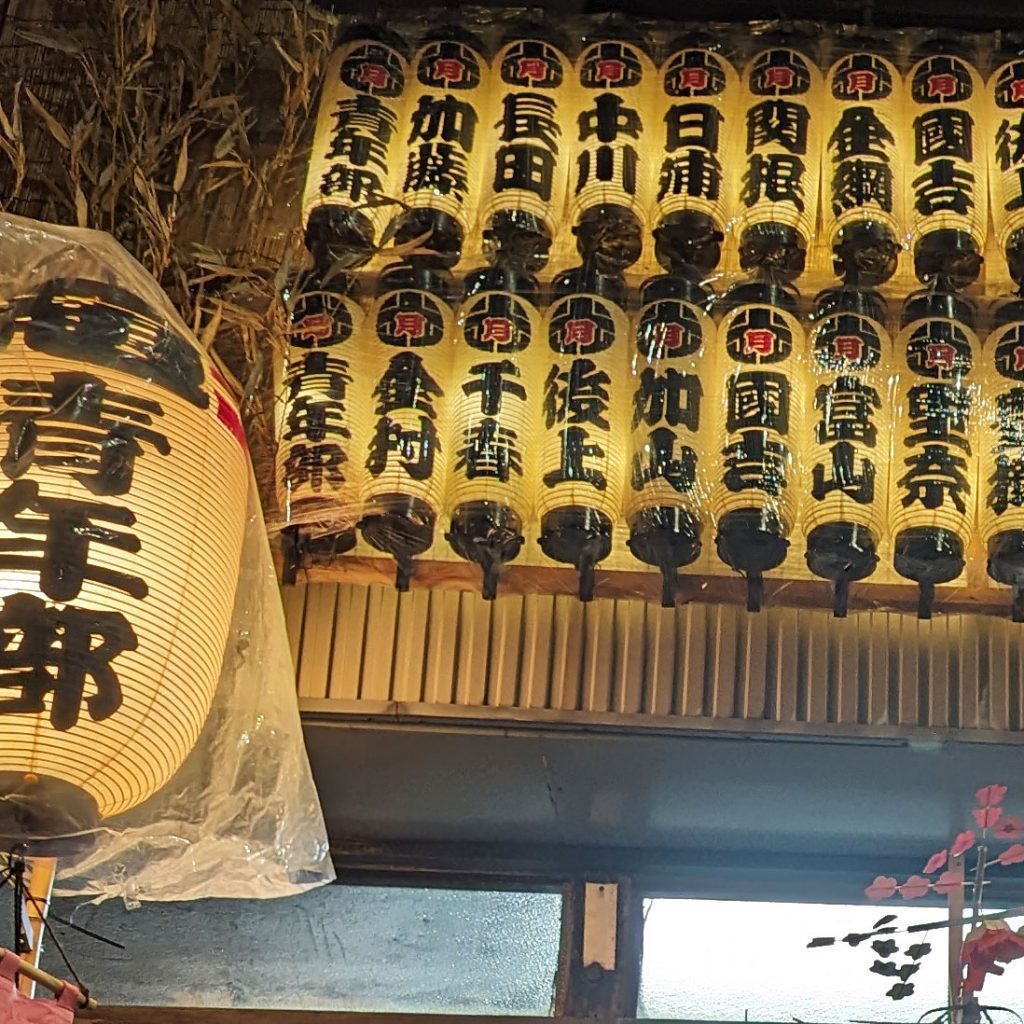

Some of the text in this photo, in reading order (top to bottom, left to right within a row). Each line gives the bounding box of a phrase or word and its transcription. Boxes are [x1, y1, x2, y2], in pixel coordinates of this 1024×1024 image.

[403, 94, 480, 203] 加藤
[494, 92, 562, 201] 長田
[575, 92, 643, 196] 中川
[740, 100, 811, 213] 関根
